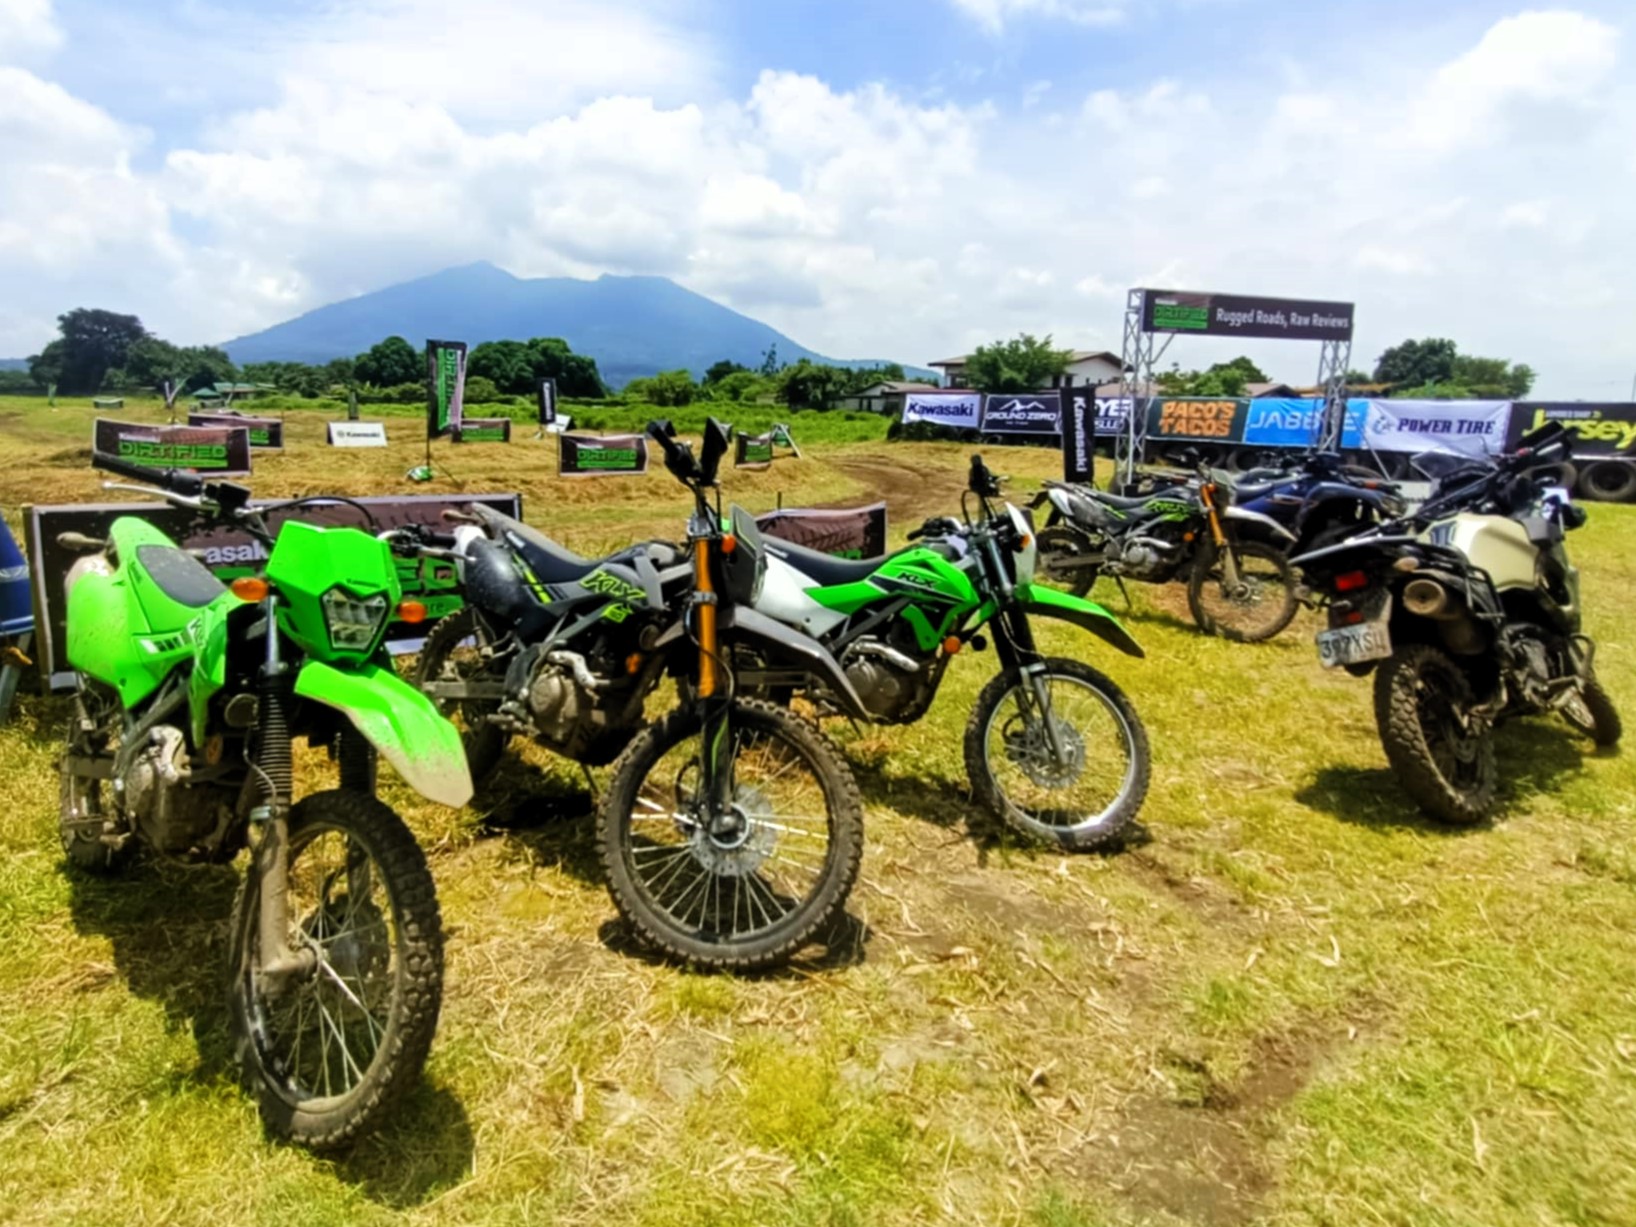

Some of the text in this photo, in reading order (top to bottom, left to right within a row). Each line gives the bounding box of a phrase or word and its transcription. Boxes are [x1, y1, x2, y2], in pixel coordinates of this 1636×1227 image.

[1216, 308, 1254, 326] Rugged
[1256, 310, 1288, 327] Roads,
[1290, 312, 1309, 325] Raw
[1311, 313, 1349, 328] Reviews
[907, 401, 975, 418] Kawasaki
[985, 411, 1057, 421] GROUND ZERO
[1162, 401, 1236, 419] PACO'S
[1159, 418, 1231, 437] TACOS
[1250, 411, 1360, 431] JABBE
[1396, 418, 1496, 435] POWER TIRE
[1521, 409, 1636, 450] Jrsey
[1073, 396, 1088, 473] Kawasaki
[118, 441, 227, 458] DIRTIFIED
[897, 571, 935, 588] KLX
